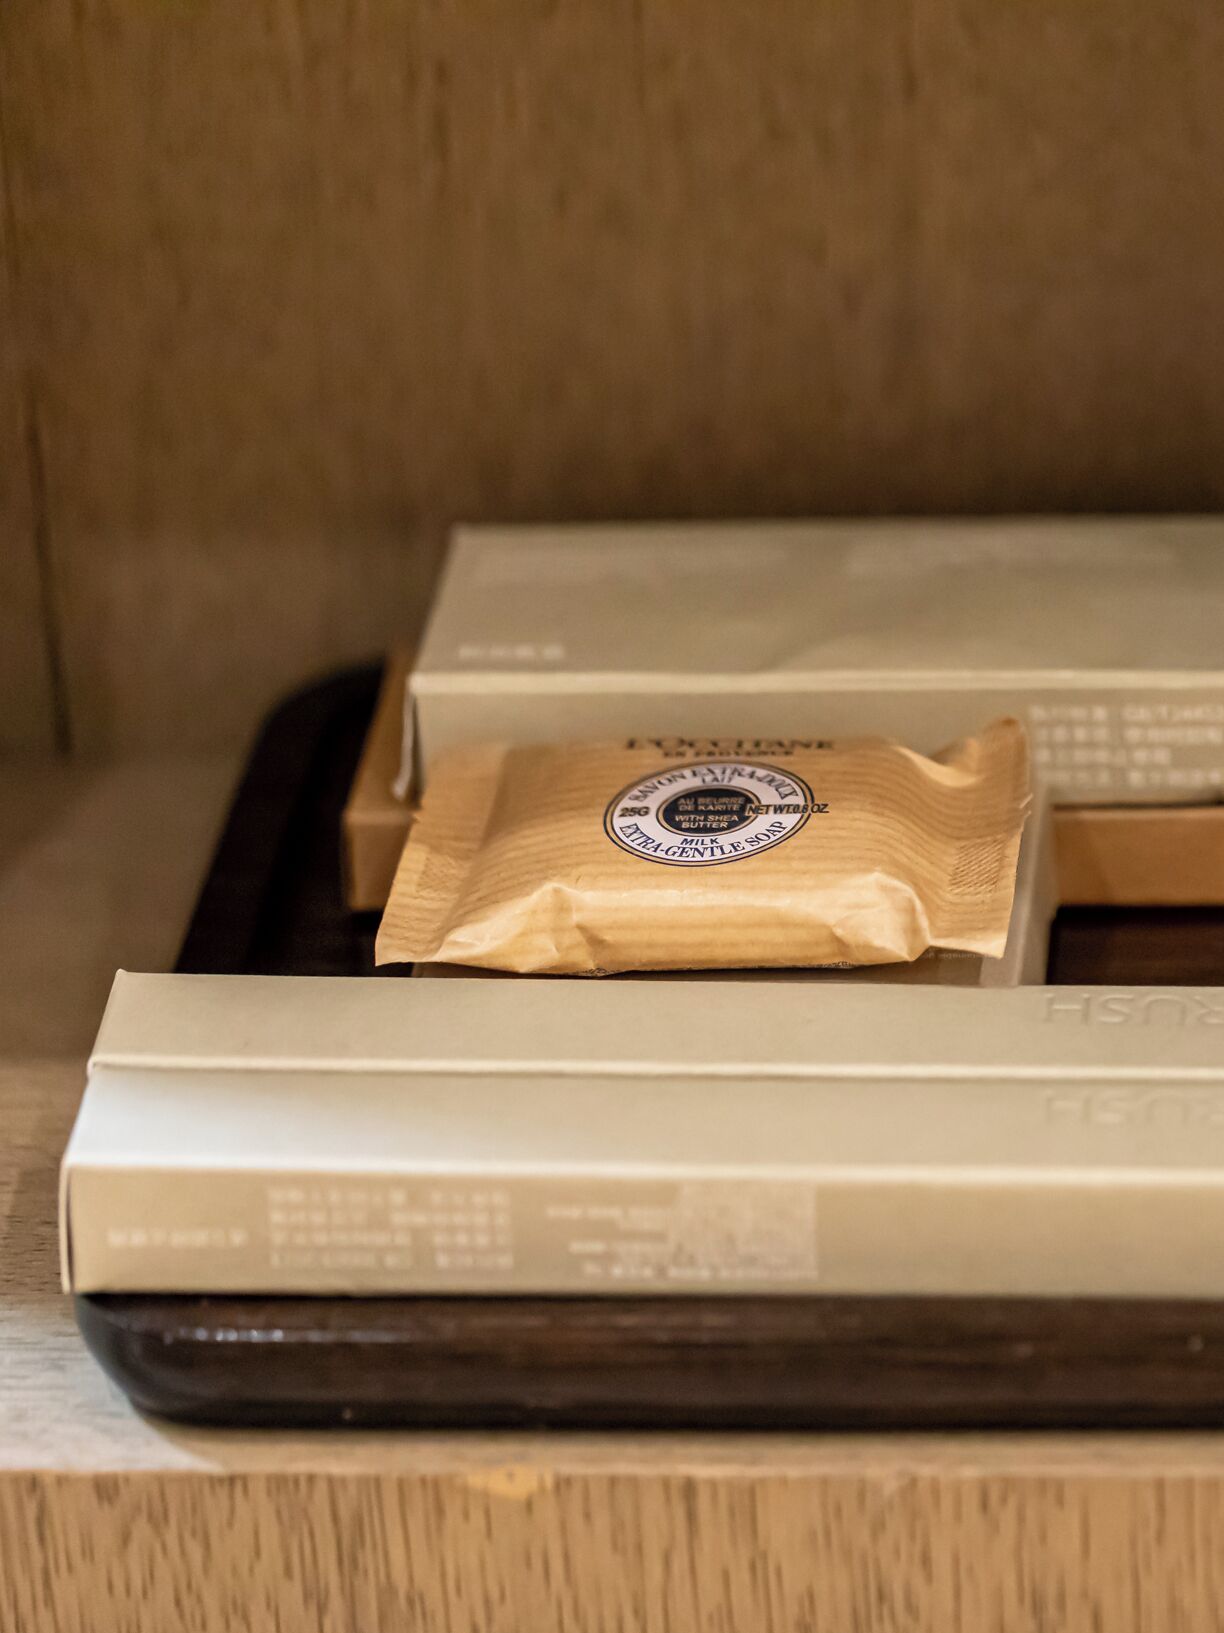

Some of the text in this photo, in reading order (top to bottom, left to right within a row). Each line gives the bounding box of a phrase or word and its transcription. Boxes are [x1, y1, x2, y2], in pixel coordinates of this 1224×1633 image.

[628, 766, 800, 802] SAVON EXTRA-DOUX
[679, 796, 745, 805] AU BEURRE
[618, 806, 651, 818] 25G
[748, 803, 774, 815] NET
[674, 815, 739, 823] WITH SHEA
[681, 821, 729, 829] BUTTER
[619, 820, 788, 859] EXTRA-GENTLE SOAP
[679, 837, 720, 847] MILK
